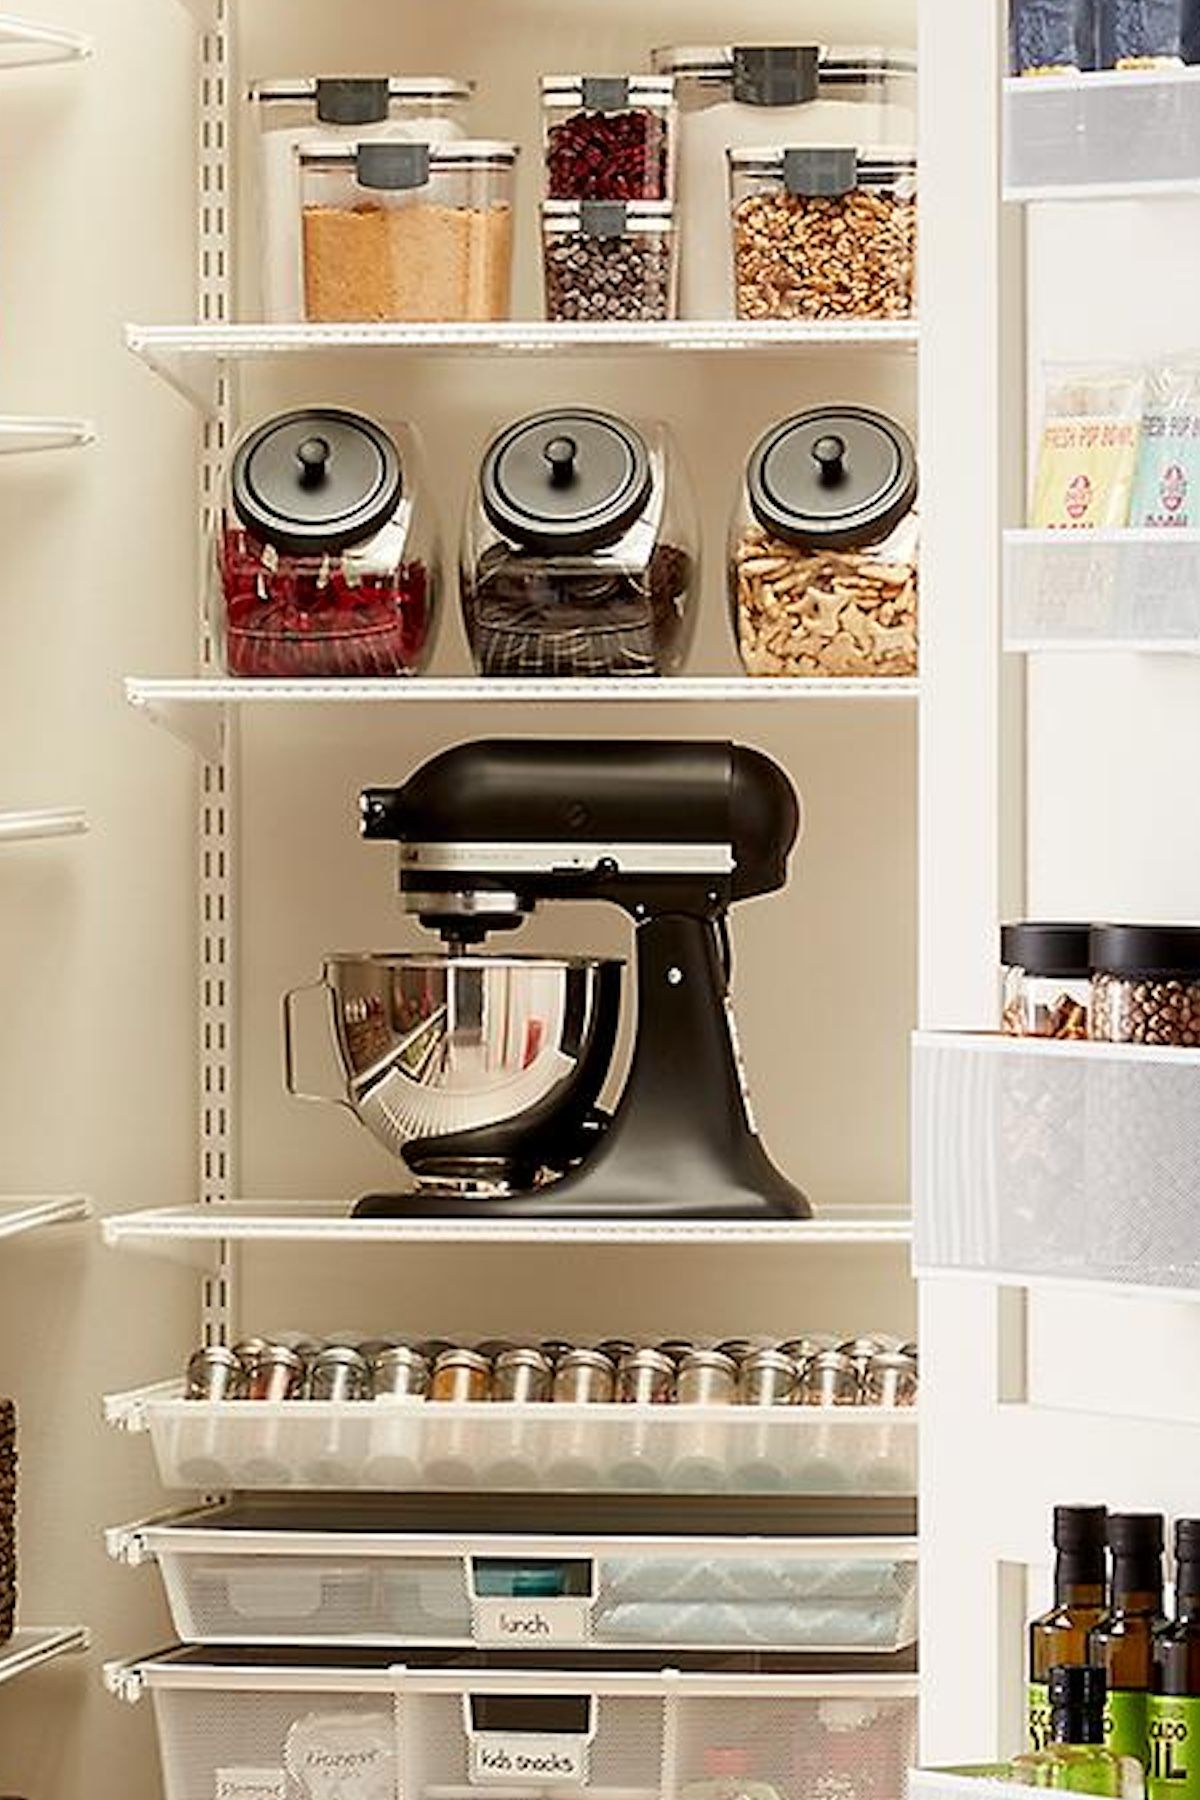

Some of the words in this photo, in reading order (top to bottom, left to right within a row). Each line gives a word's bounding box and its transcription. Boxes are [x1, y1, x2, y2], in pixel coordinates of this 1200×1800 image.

[500, 1613, 550, 1634] lunch
[481, 1748, 512, 1770] kids
[515, 1752, 574, 1772] snacks
